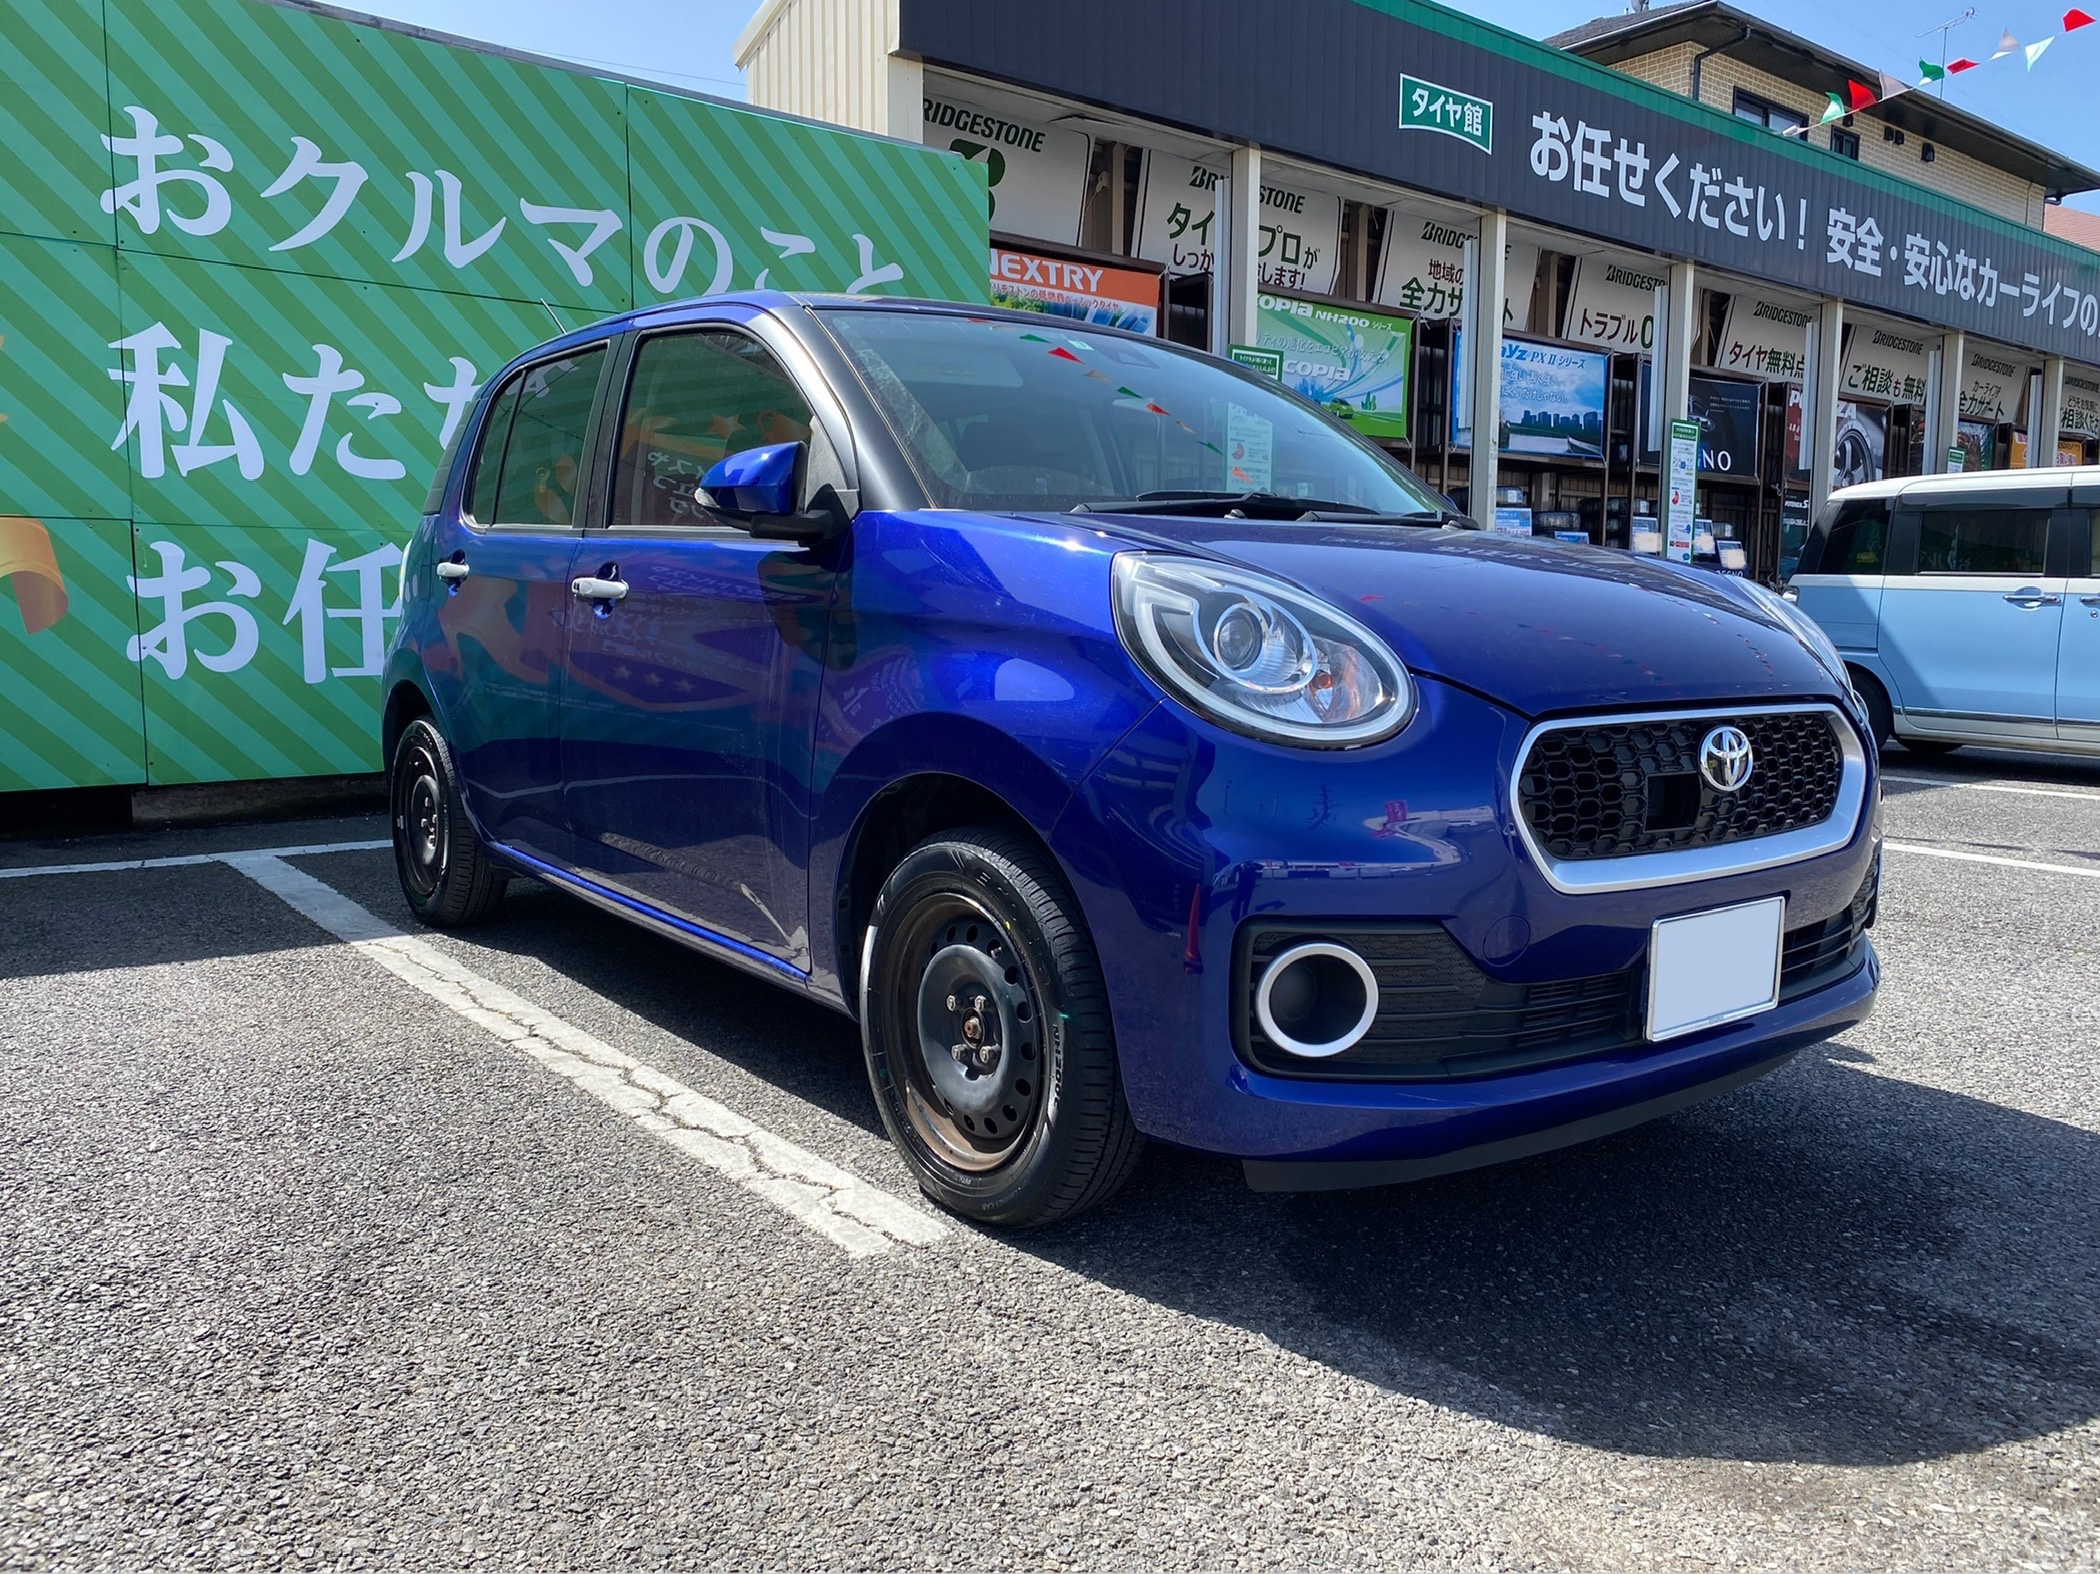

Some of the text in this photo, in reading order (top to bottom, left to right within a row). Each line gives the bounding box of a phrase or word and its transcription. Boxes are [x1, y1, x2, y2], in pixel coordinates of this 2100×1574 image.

[1411, 88, 1483, 137] タイヤ館
[1530, 110, 1807, 250] お任せください！
[99, 105, 904, 297] おクルマのこと
[1315, 309, 1370, 329] NH200
[1372, 321, 1393, 332] シリーズ
[1872, 330, 1924, 355] BRIDGESTONE
[1558, 356, 1587, 369] シリーズ
[1971, 353, 2016, 378] BRIDGESTONE
